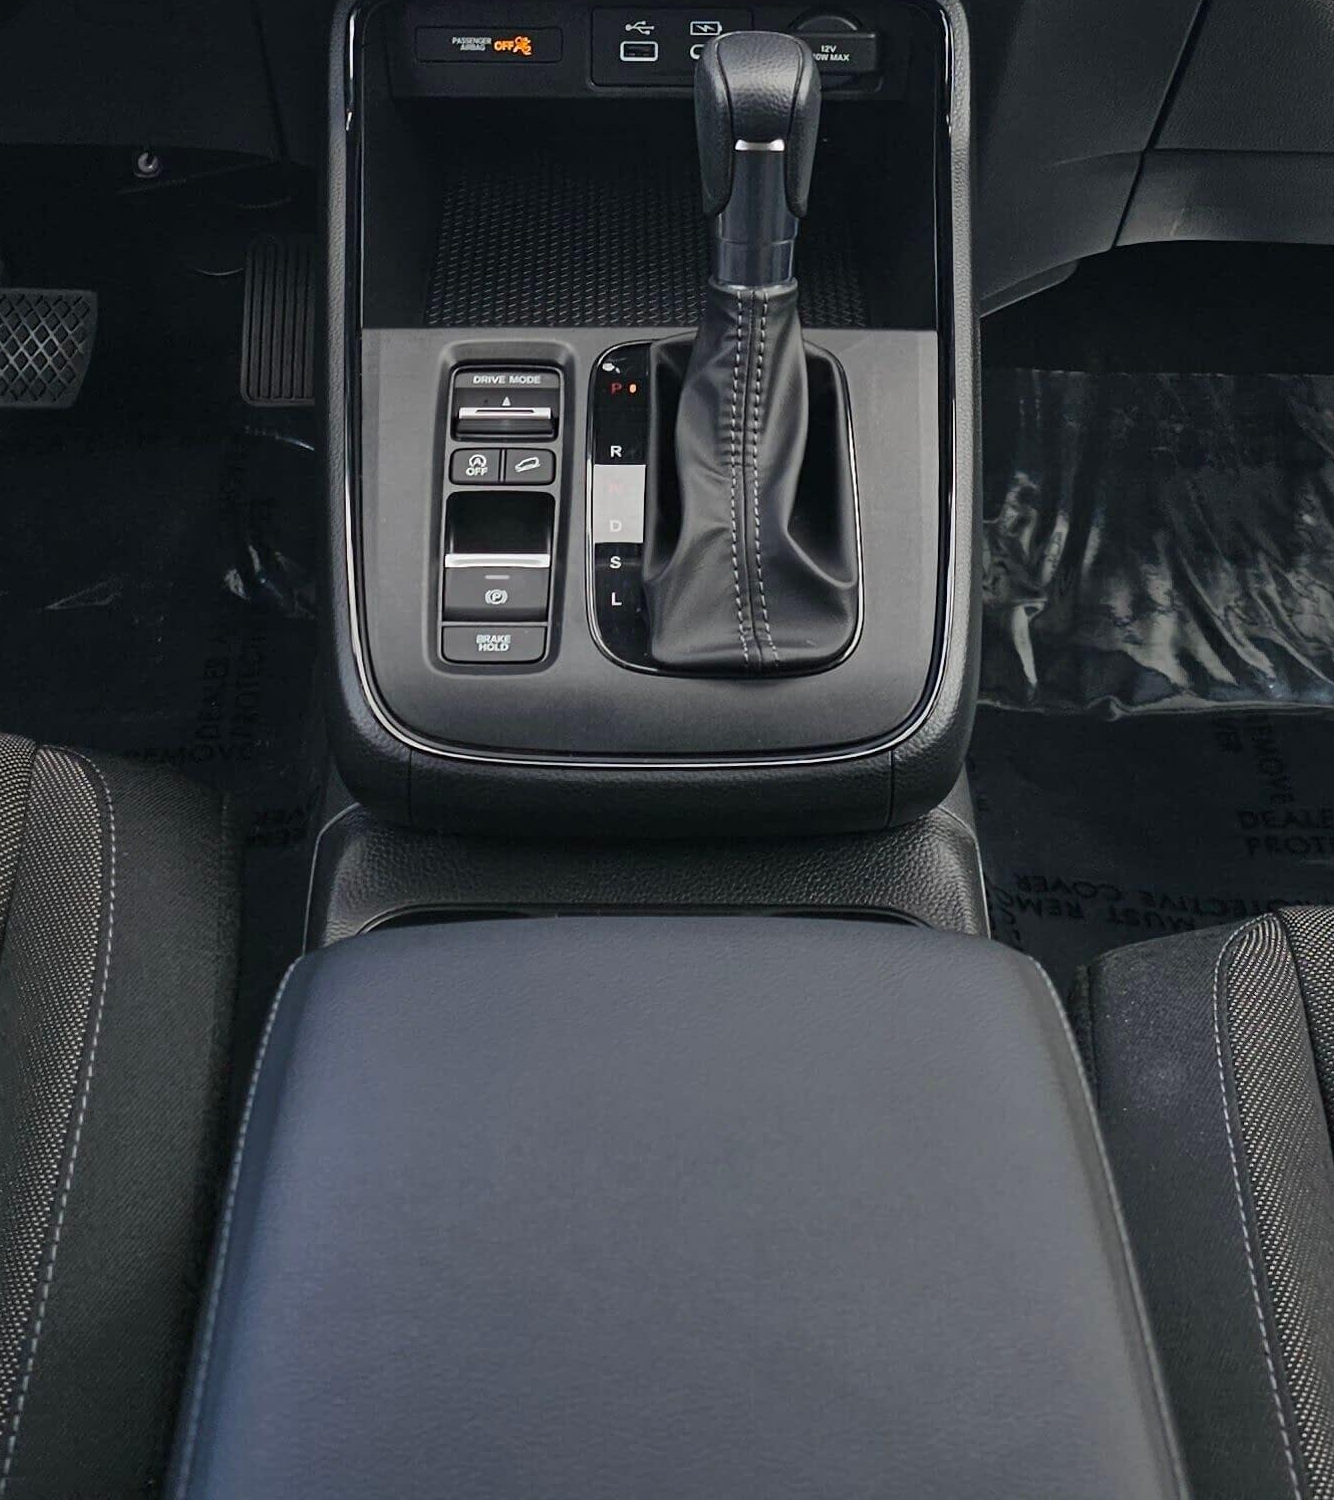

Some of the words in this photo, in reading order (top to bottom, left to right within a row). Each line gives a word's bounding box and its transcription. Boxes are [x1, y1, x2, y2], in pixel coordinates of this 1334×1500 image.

[494, 40, 514, 51] OFF
[821, 44, 837, 53] 12V
[830, 53, 850, 62] MAX
[473, 375, 505, 385] DRIVE
[509, 375, 541, 385] MODE
[611, 382, 622, 394] P
[610, 445, 622, 458] R
[466, 466, 488, 477] OFF
[610, 520, 622, 532] D
[610, 555, 622, 569] S
[611, 592, 622, 605] L
[476, 633, 511, 645] BRAKE
[478, 643, 510, 653] HOLD
